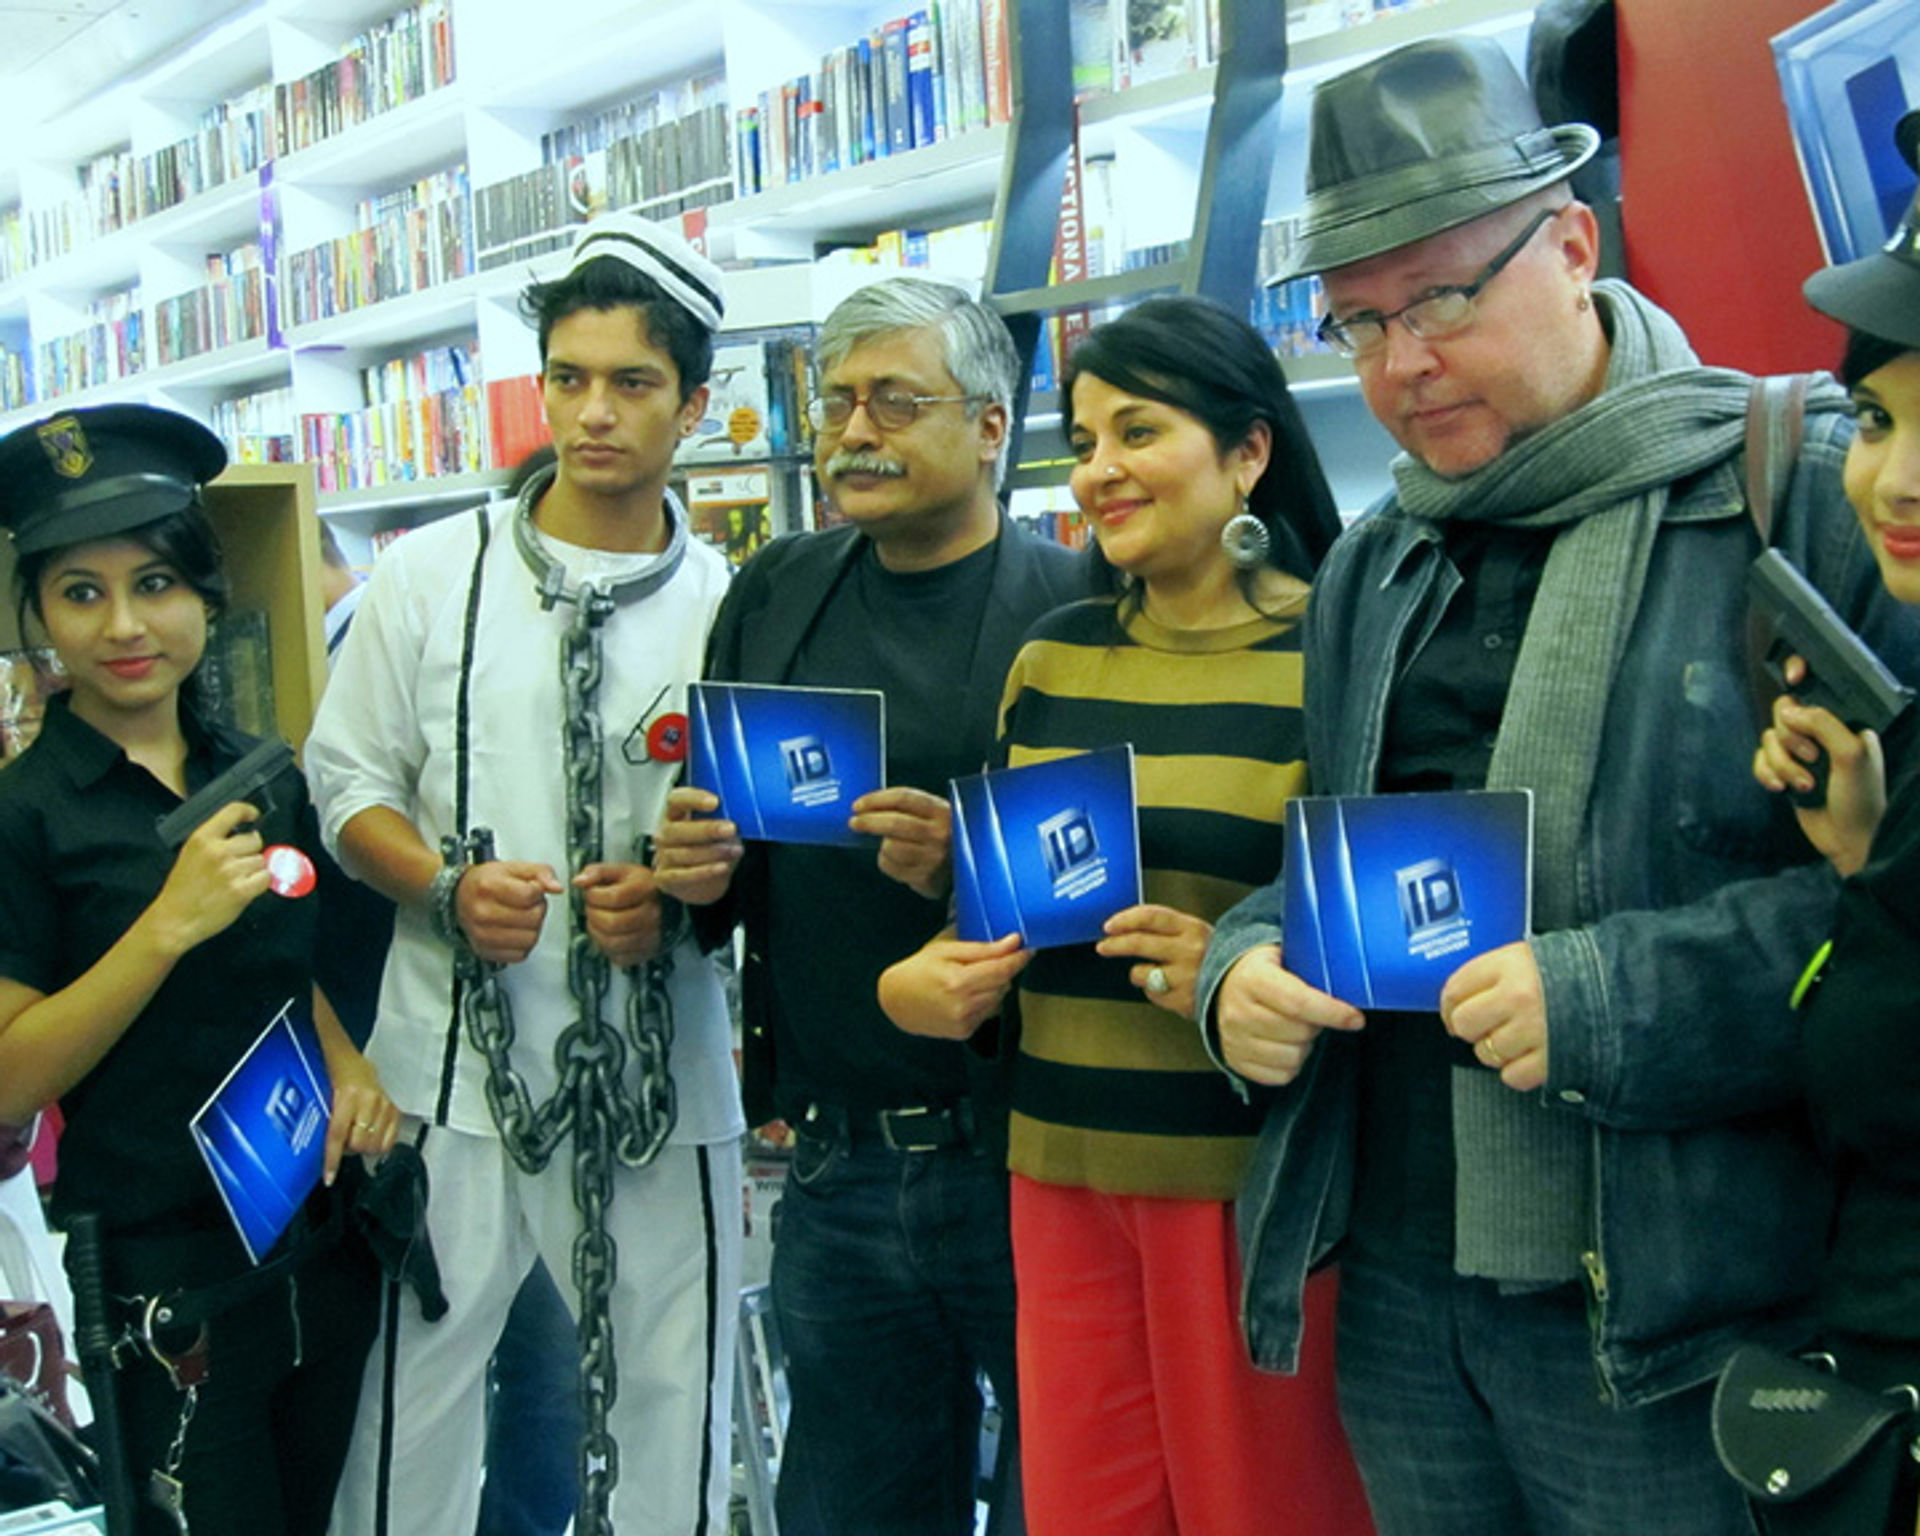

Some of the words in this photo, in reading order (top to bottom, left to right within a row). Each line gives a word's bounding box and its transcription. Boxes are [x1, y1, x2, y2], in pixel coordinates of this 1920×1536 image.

[786, 741, 831, 787] ID
[1045, 813, 1097, 875] ID
[1404, 866, 1461, 929] ID
